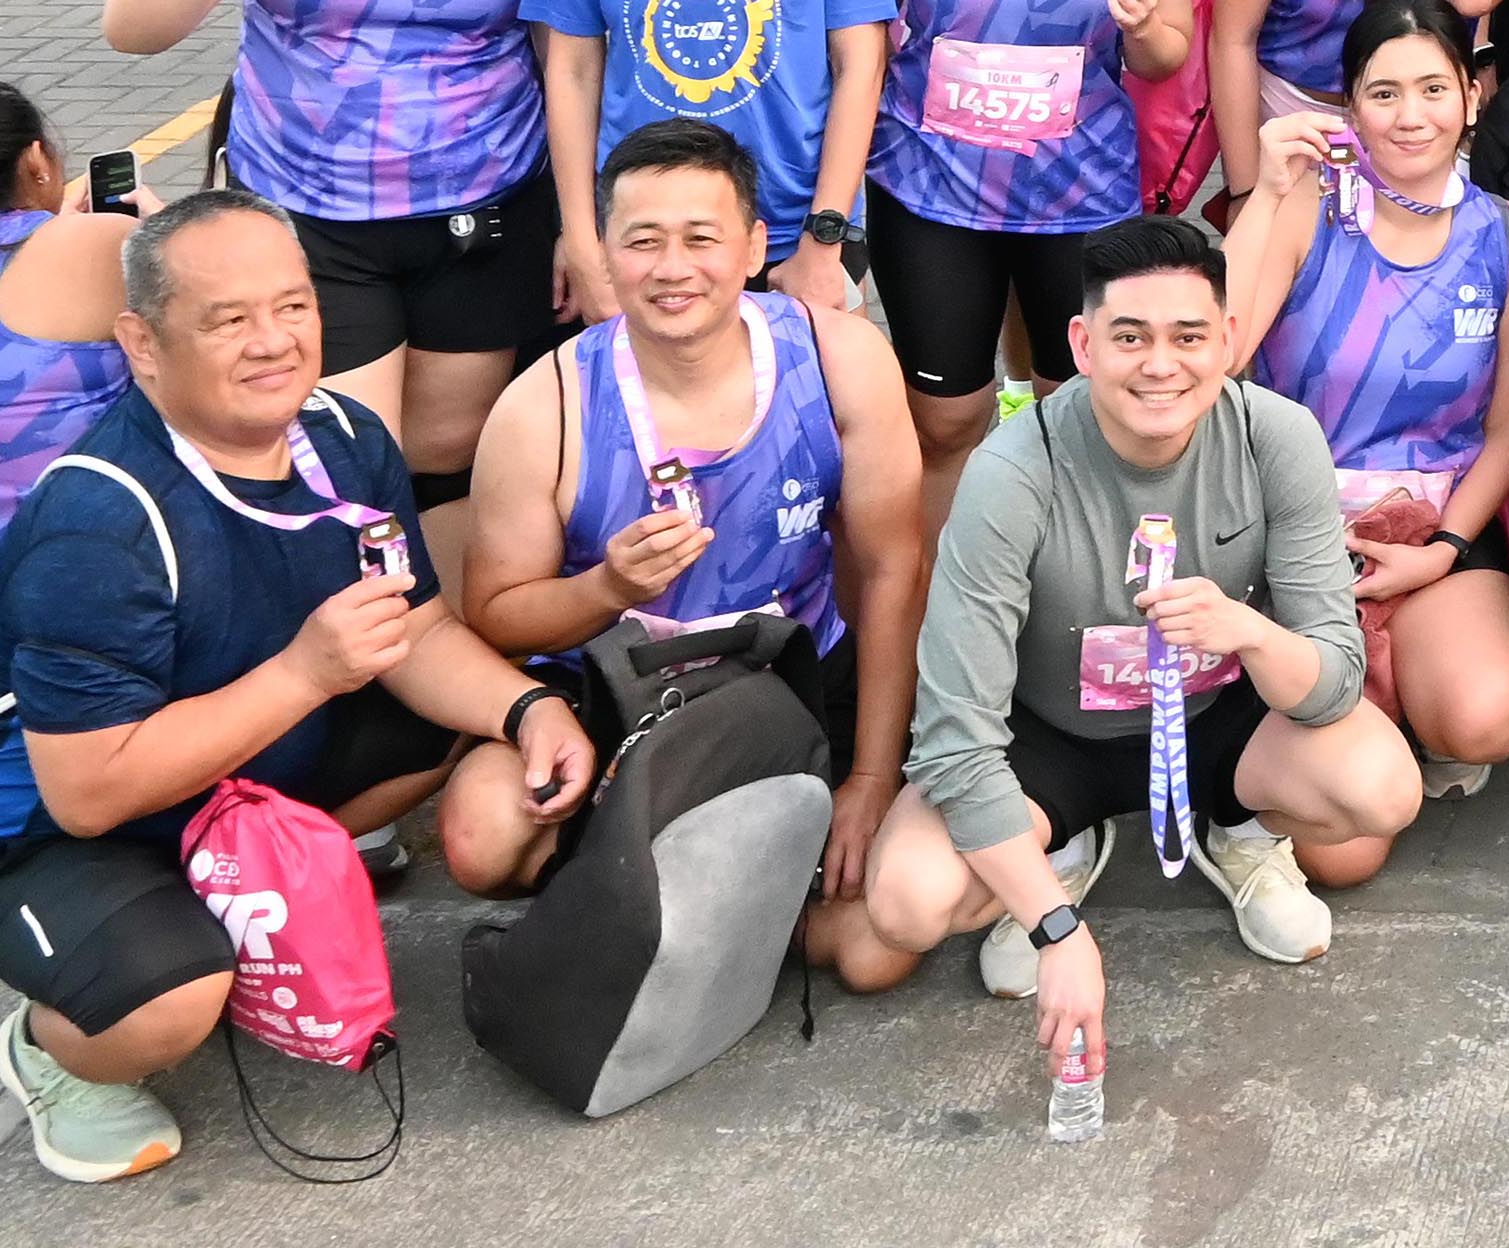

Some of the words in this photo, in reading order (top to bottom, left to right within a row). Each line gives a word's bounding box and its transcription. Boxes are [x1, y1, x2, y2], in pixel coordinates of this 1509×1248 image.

[987, 71, 1023, 85] 10KM
[944, 82, 1051, 123] 14575
[1454, 308, 1498, 337] WR
[239, 963, 276, 976] RUN
[278, 963, 303, 976] PH
